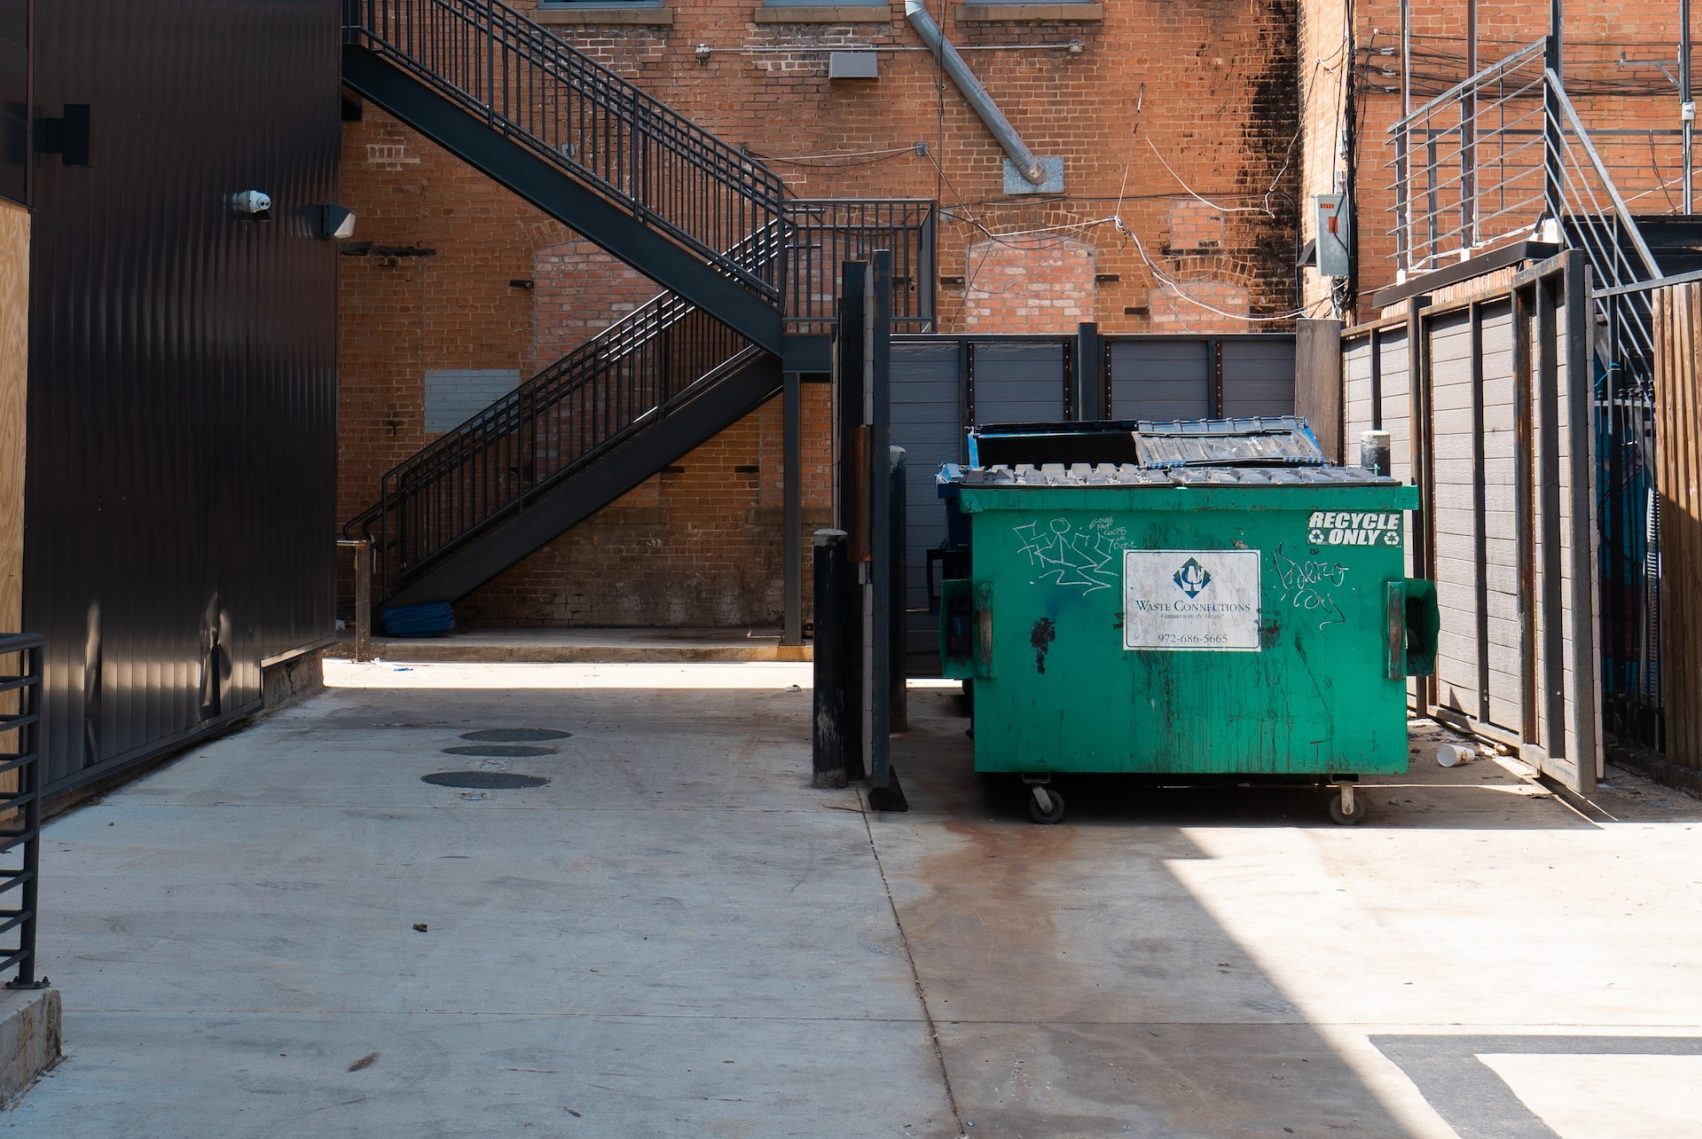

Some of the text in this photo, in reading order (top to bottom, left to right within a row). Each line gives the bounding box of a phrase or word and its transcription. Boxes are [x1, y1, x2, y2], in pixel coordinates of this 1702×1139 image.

[1309, 511, 1400, 530] RECYCLE
[1328, 528, 1381, 546] ONLY
[1158, 633, 1228, 644] 972-686-5665
